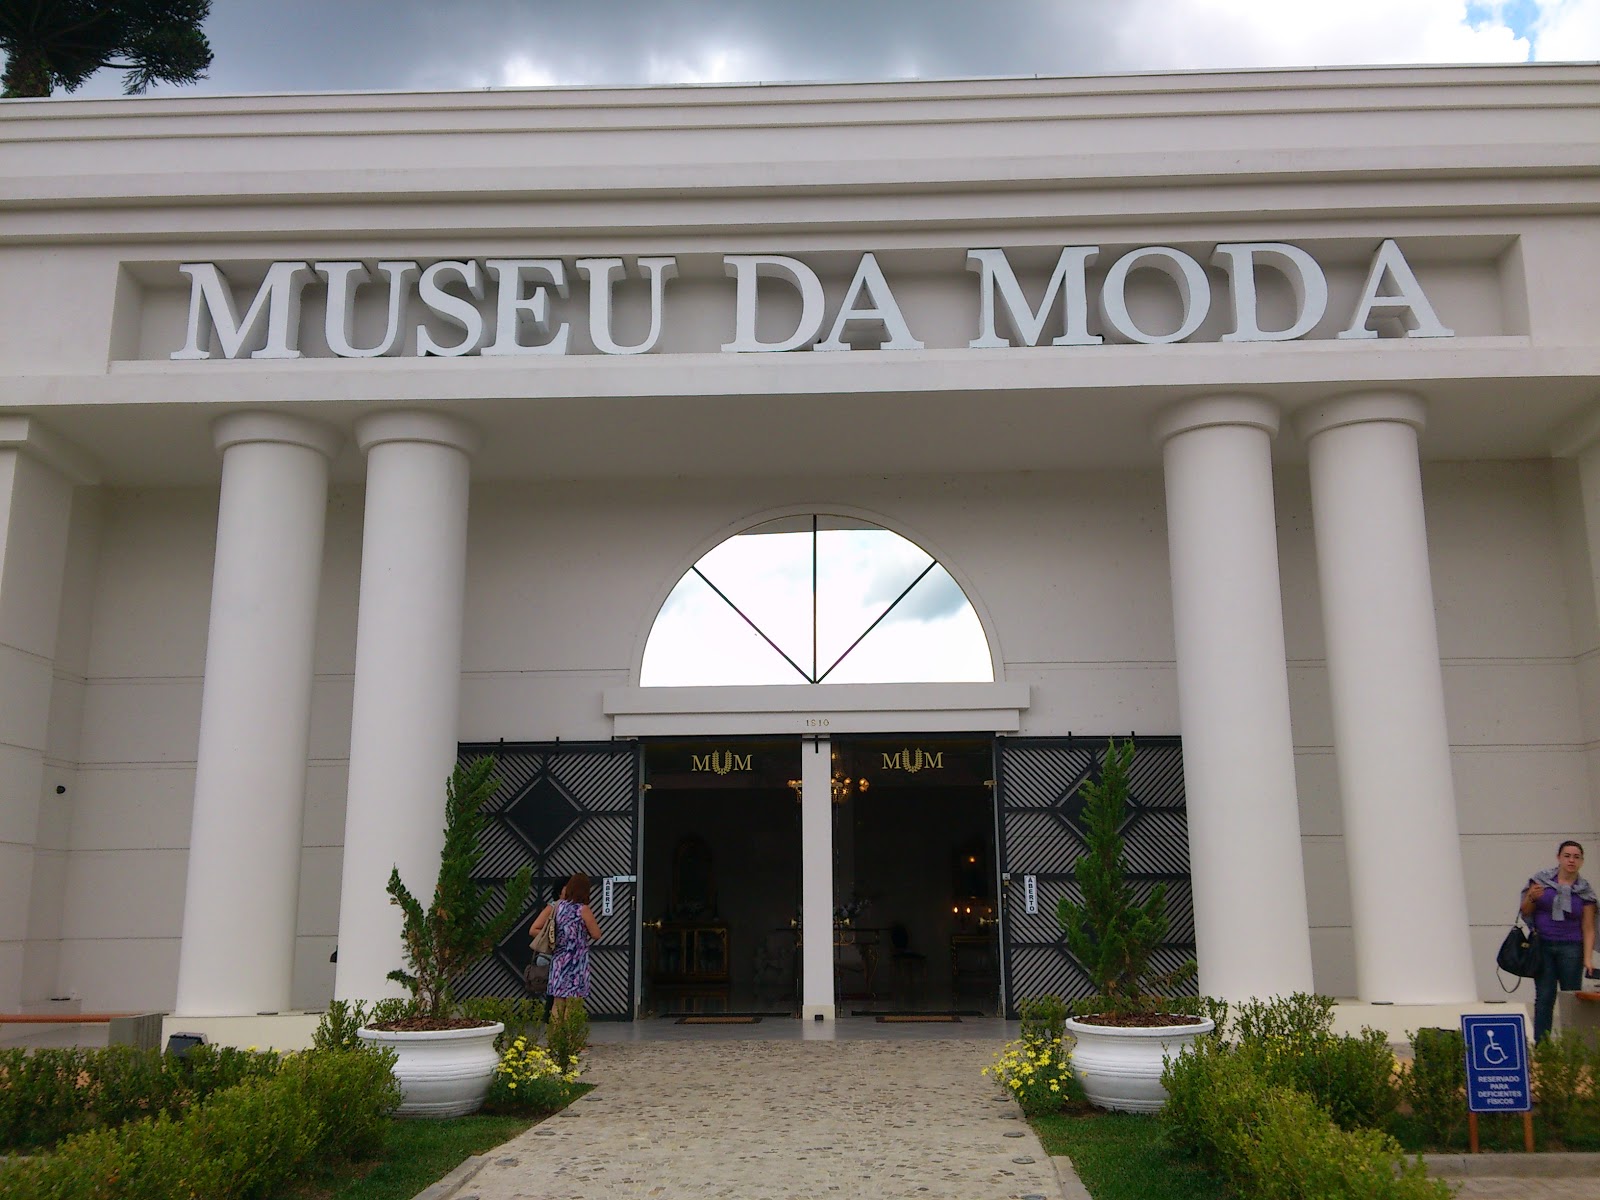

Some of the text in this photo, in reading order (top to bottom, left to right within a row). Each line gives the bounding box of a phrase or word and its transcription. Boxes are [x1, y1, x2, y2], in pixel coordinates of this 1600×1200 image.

[170, 239, 1455, 360] MUSEU DA MODA
[691, 750, 753, 776] MUM
[881, 747, 944, 773] MUM
[604, 878, 612, 914] ABERTO
[1027, 876, 1035, 912] ABERTO
[1477, 1075, 1521, 1083] RESERVADO
[1477, 1090, 1523, 1098] DEFICIENTES
